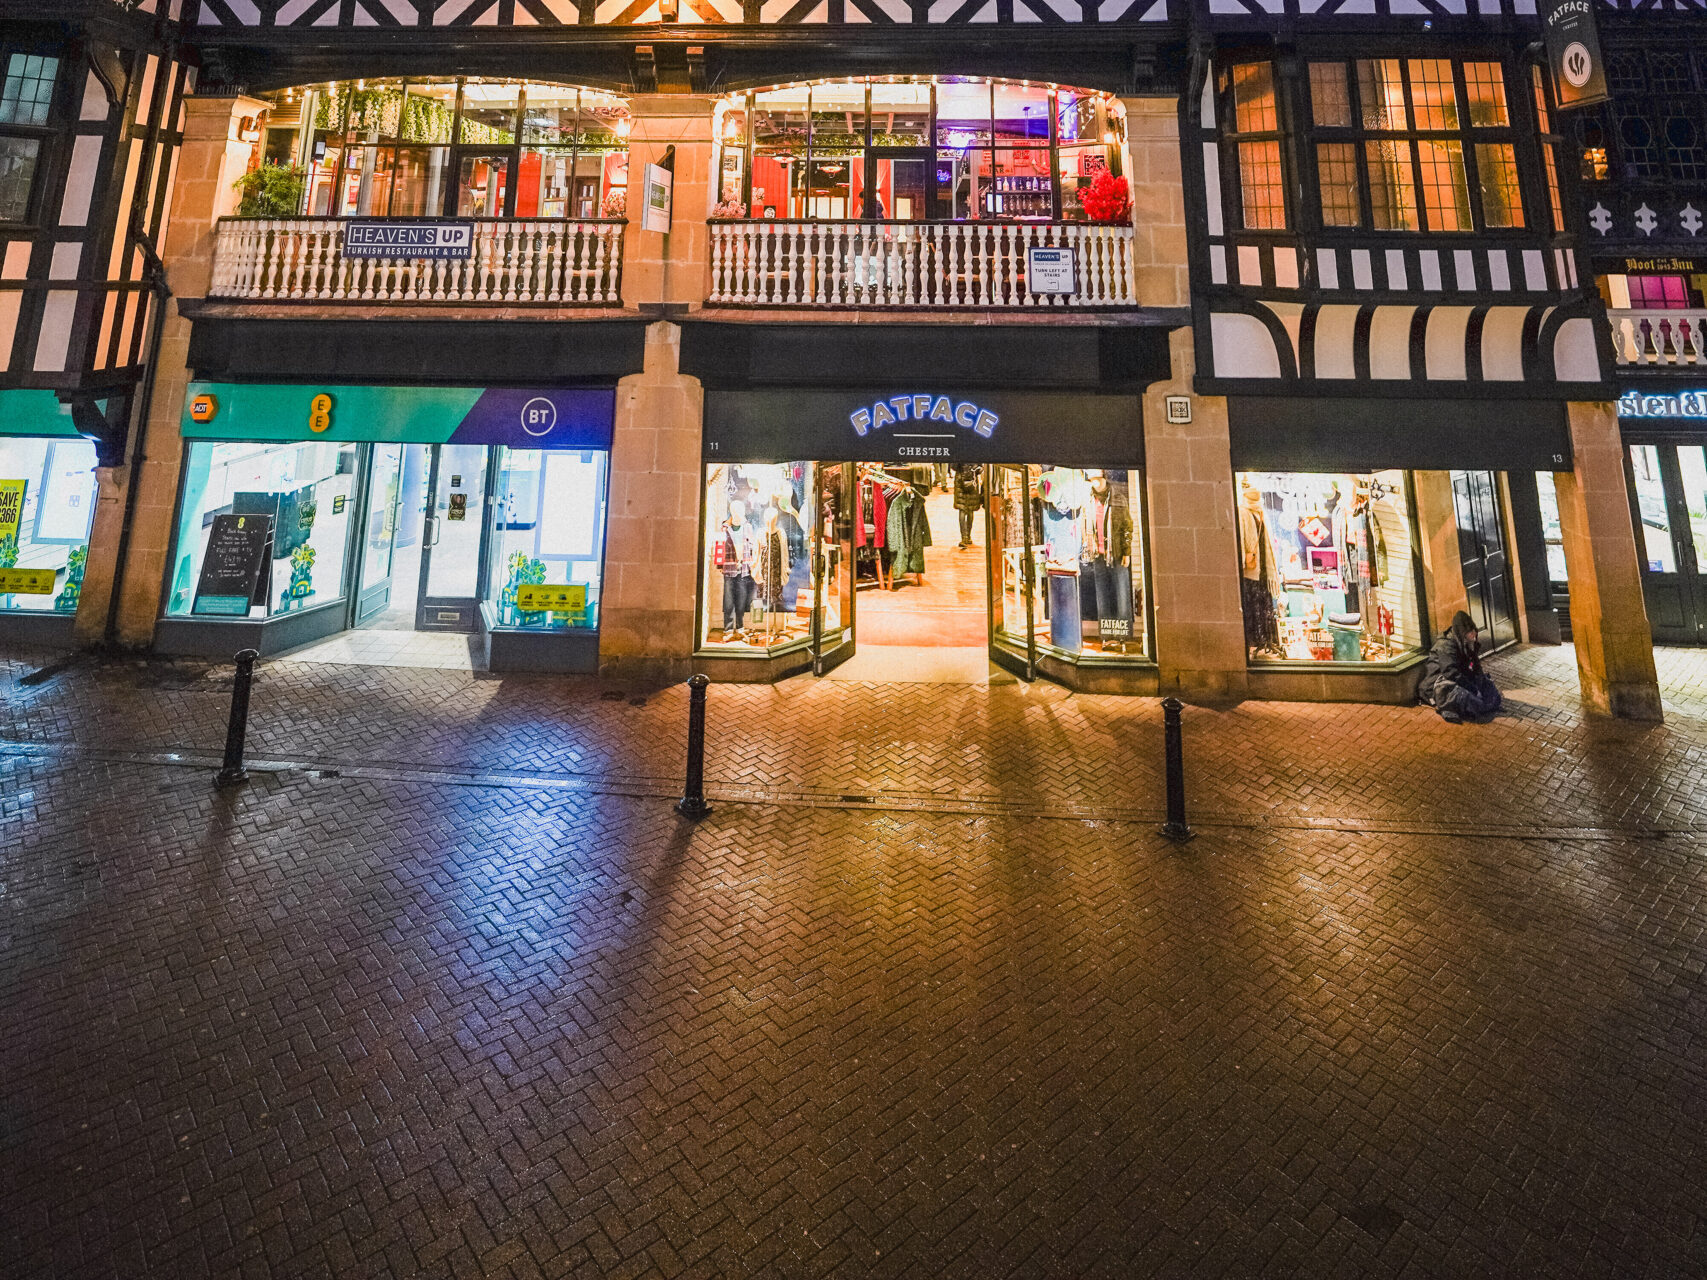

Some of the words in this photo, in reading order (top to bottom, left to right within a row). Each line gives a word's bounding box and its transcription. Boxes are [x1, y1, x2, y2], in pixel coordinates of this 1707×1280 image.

[1548, 1, 1589, 26] FATFACE
[352, 228, 435, 243] HEAVEN'S
[442, 230, 464, 242] UP
[346, 246, 382, 255] TURKISH
[385, 247, 440, 255] RESTAURANT
[452, 248, 468, 256] BAR
[1671, 257, 1694, 270] Inn
[193, 403, 208, 413] ADT
[529, 410, 549, 424] BT
[850, 395, 999, 438] FATFACE
[709, 442, 719, 450] 11
[898, 447, 950, 456] CHESTER
[1552, 455, 1563, 463] 13
[0, 507, 17, 524] 366
[1100, 619, 1129, 629] FATFACE
